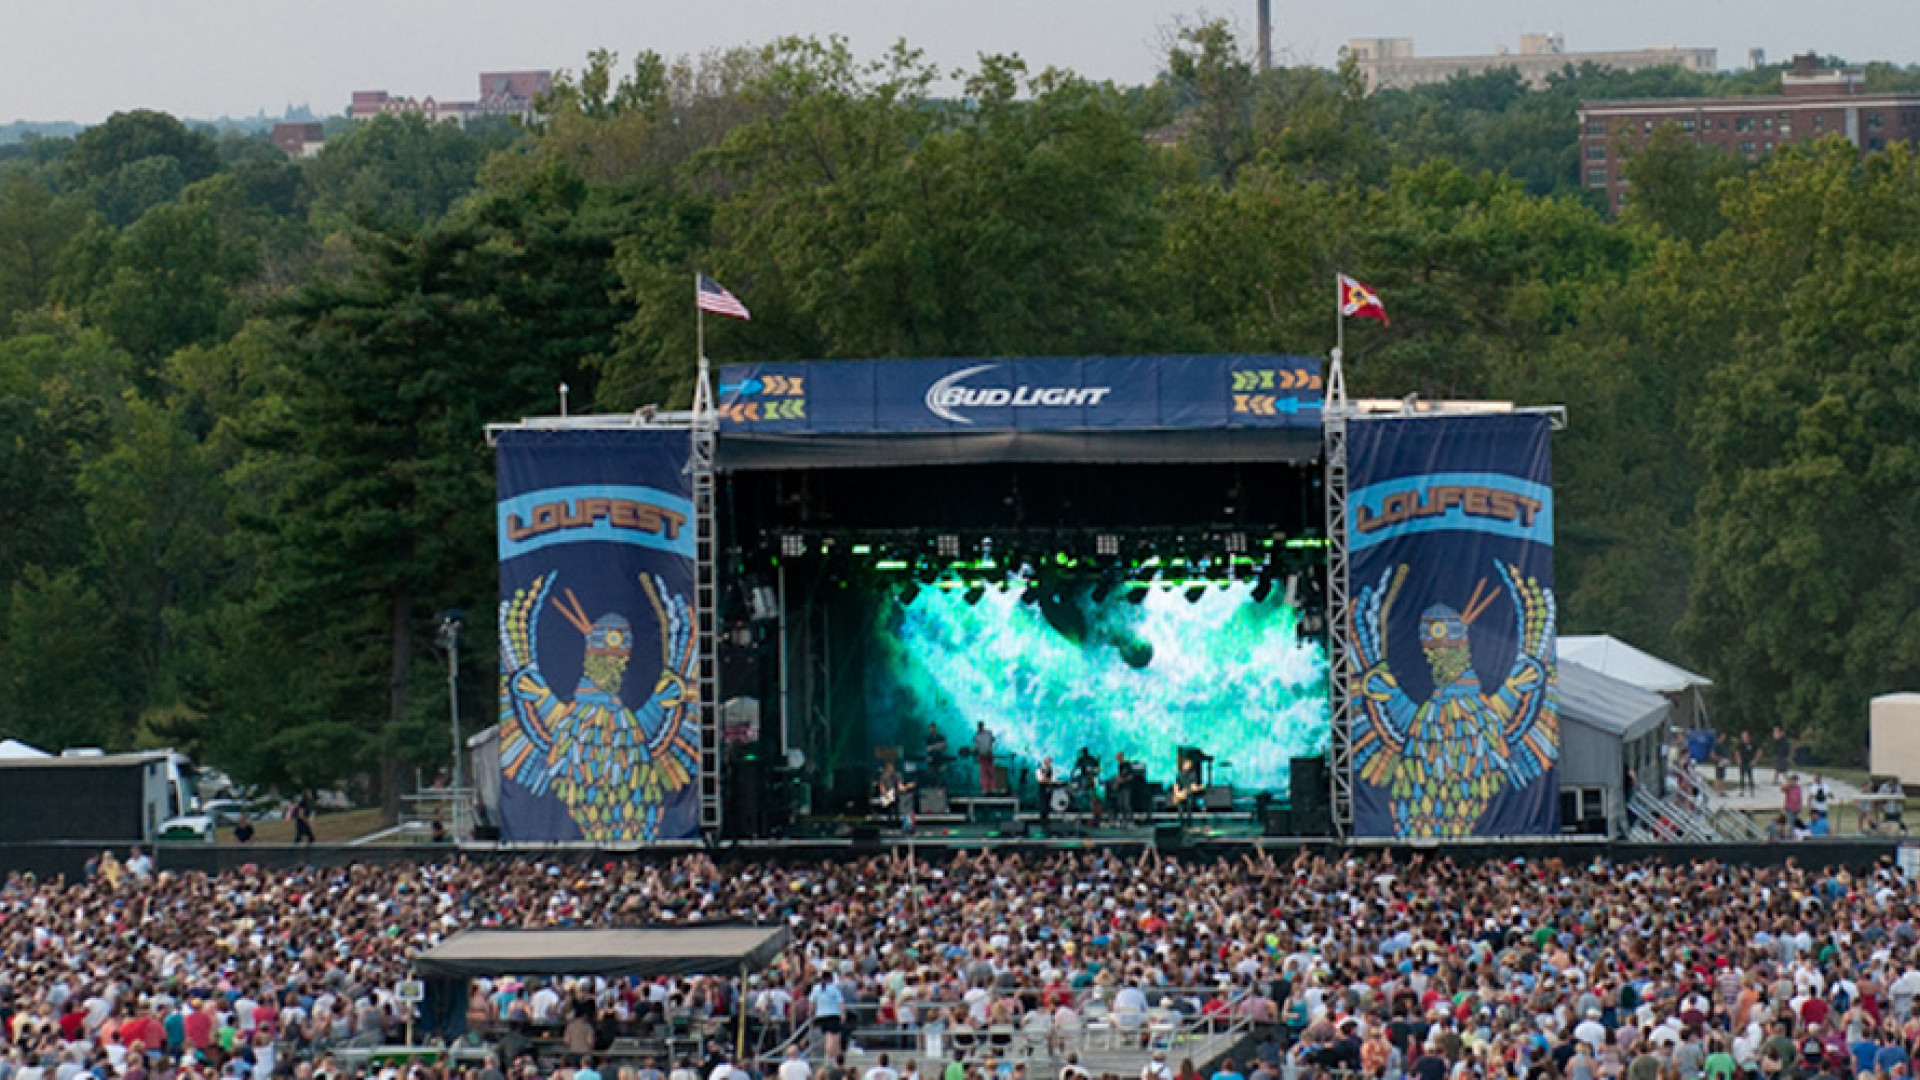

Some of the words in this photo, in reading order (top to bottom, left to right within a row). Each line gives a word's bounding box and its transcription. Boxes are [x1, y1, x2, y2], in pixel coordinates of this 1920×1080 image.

[940, 386, 1011, 407] BUD
[1011, 386, 1111, 407] LIGHT
[508, 497, 686, 541] LOUFEST
[1357, 486, 1542, 533] LOUFEST
